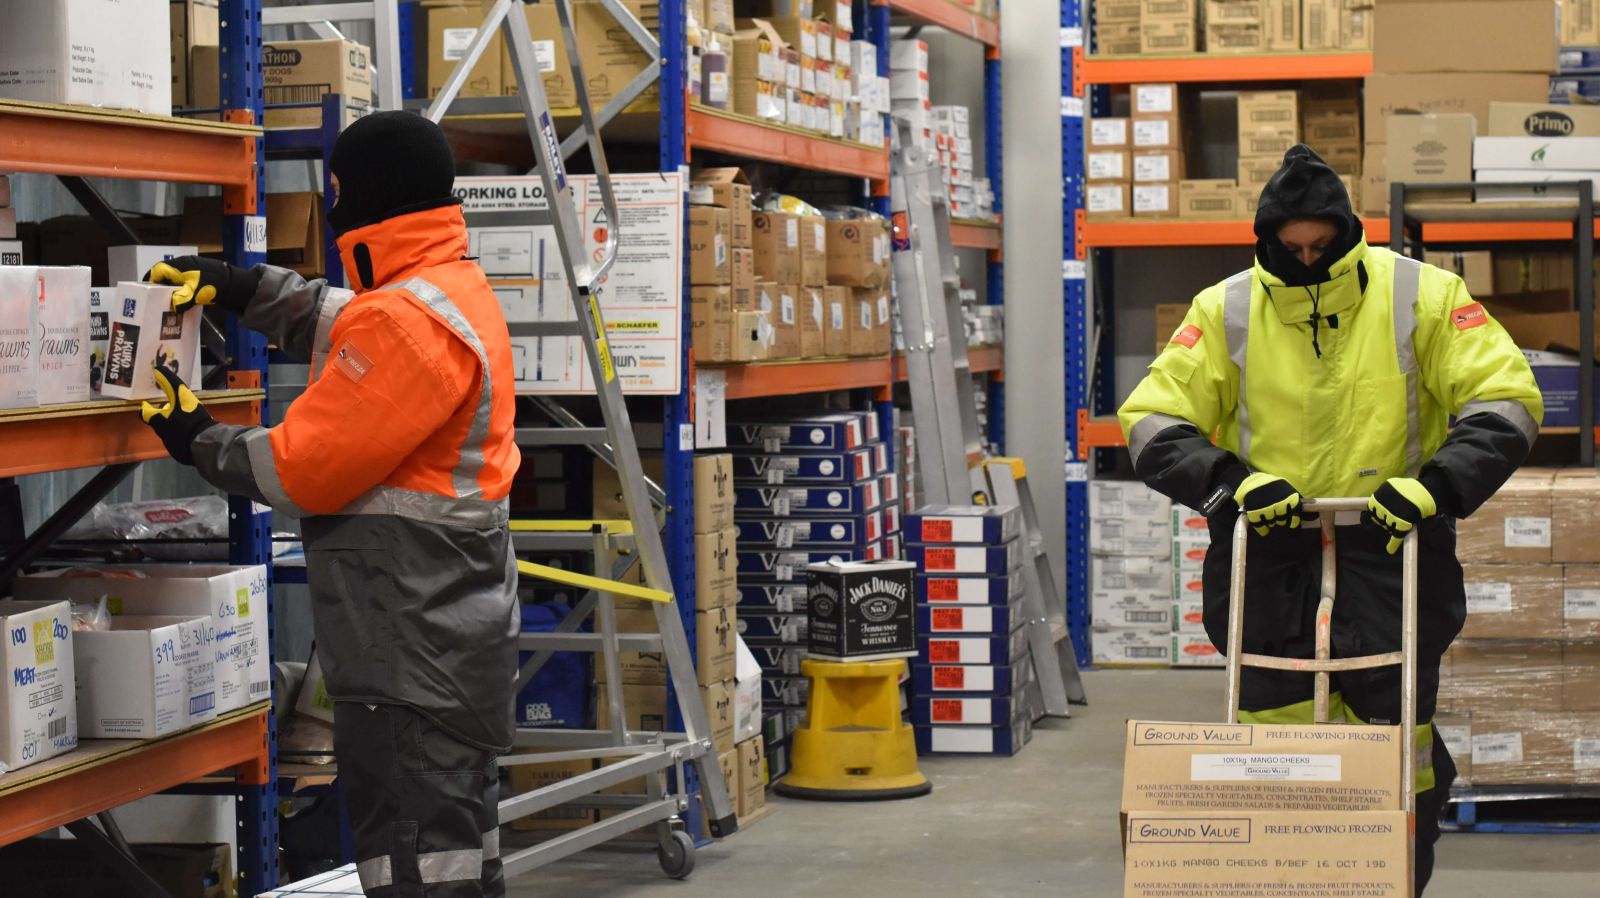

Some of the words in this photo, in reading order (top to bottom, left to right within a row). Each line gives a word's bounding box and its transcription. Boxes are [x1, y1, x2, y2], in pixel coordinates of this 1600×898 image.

[1529, 116, 1572, 132] Primo
[110, 330, 126, 380] PRAWNS
[123, 341, 134, 368] KURO
[850, 582, 872, 604] JACK
[872, 576, 908, 602] DANIEL'S
[12, 627, 26, 646] 100
[53, 618, 68, 640] 200
[860, 622, 898, 632] Tennessee
[862, 636, 898, 645] WHISKEY
[156, 639, 174, 664] 399
[14, 666, 35, 687] MEAT
[1144, 728, 1198, 740] GROUND
[1203, 729, 1242, 740] VALUE
[1294, 732, 1346, 740] FLOWING
[1348, 733, 1391, 742] FROZEN
[1222, 757, 1247, 766] 10X1kg
[1140, 824, 1196, 838] GROUND
[1200, 824, 1240, 838] VALUE
[1264, 826, 1290, 834] FREE
[1293, 825, 1346, 834] FLOWING
[1349, 824, 1392, 833] FROZEN
[1226, 859, 1268, 867] CHEEKS
[1336, 860, 1358, 868] OCT
